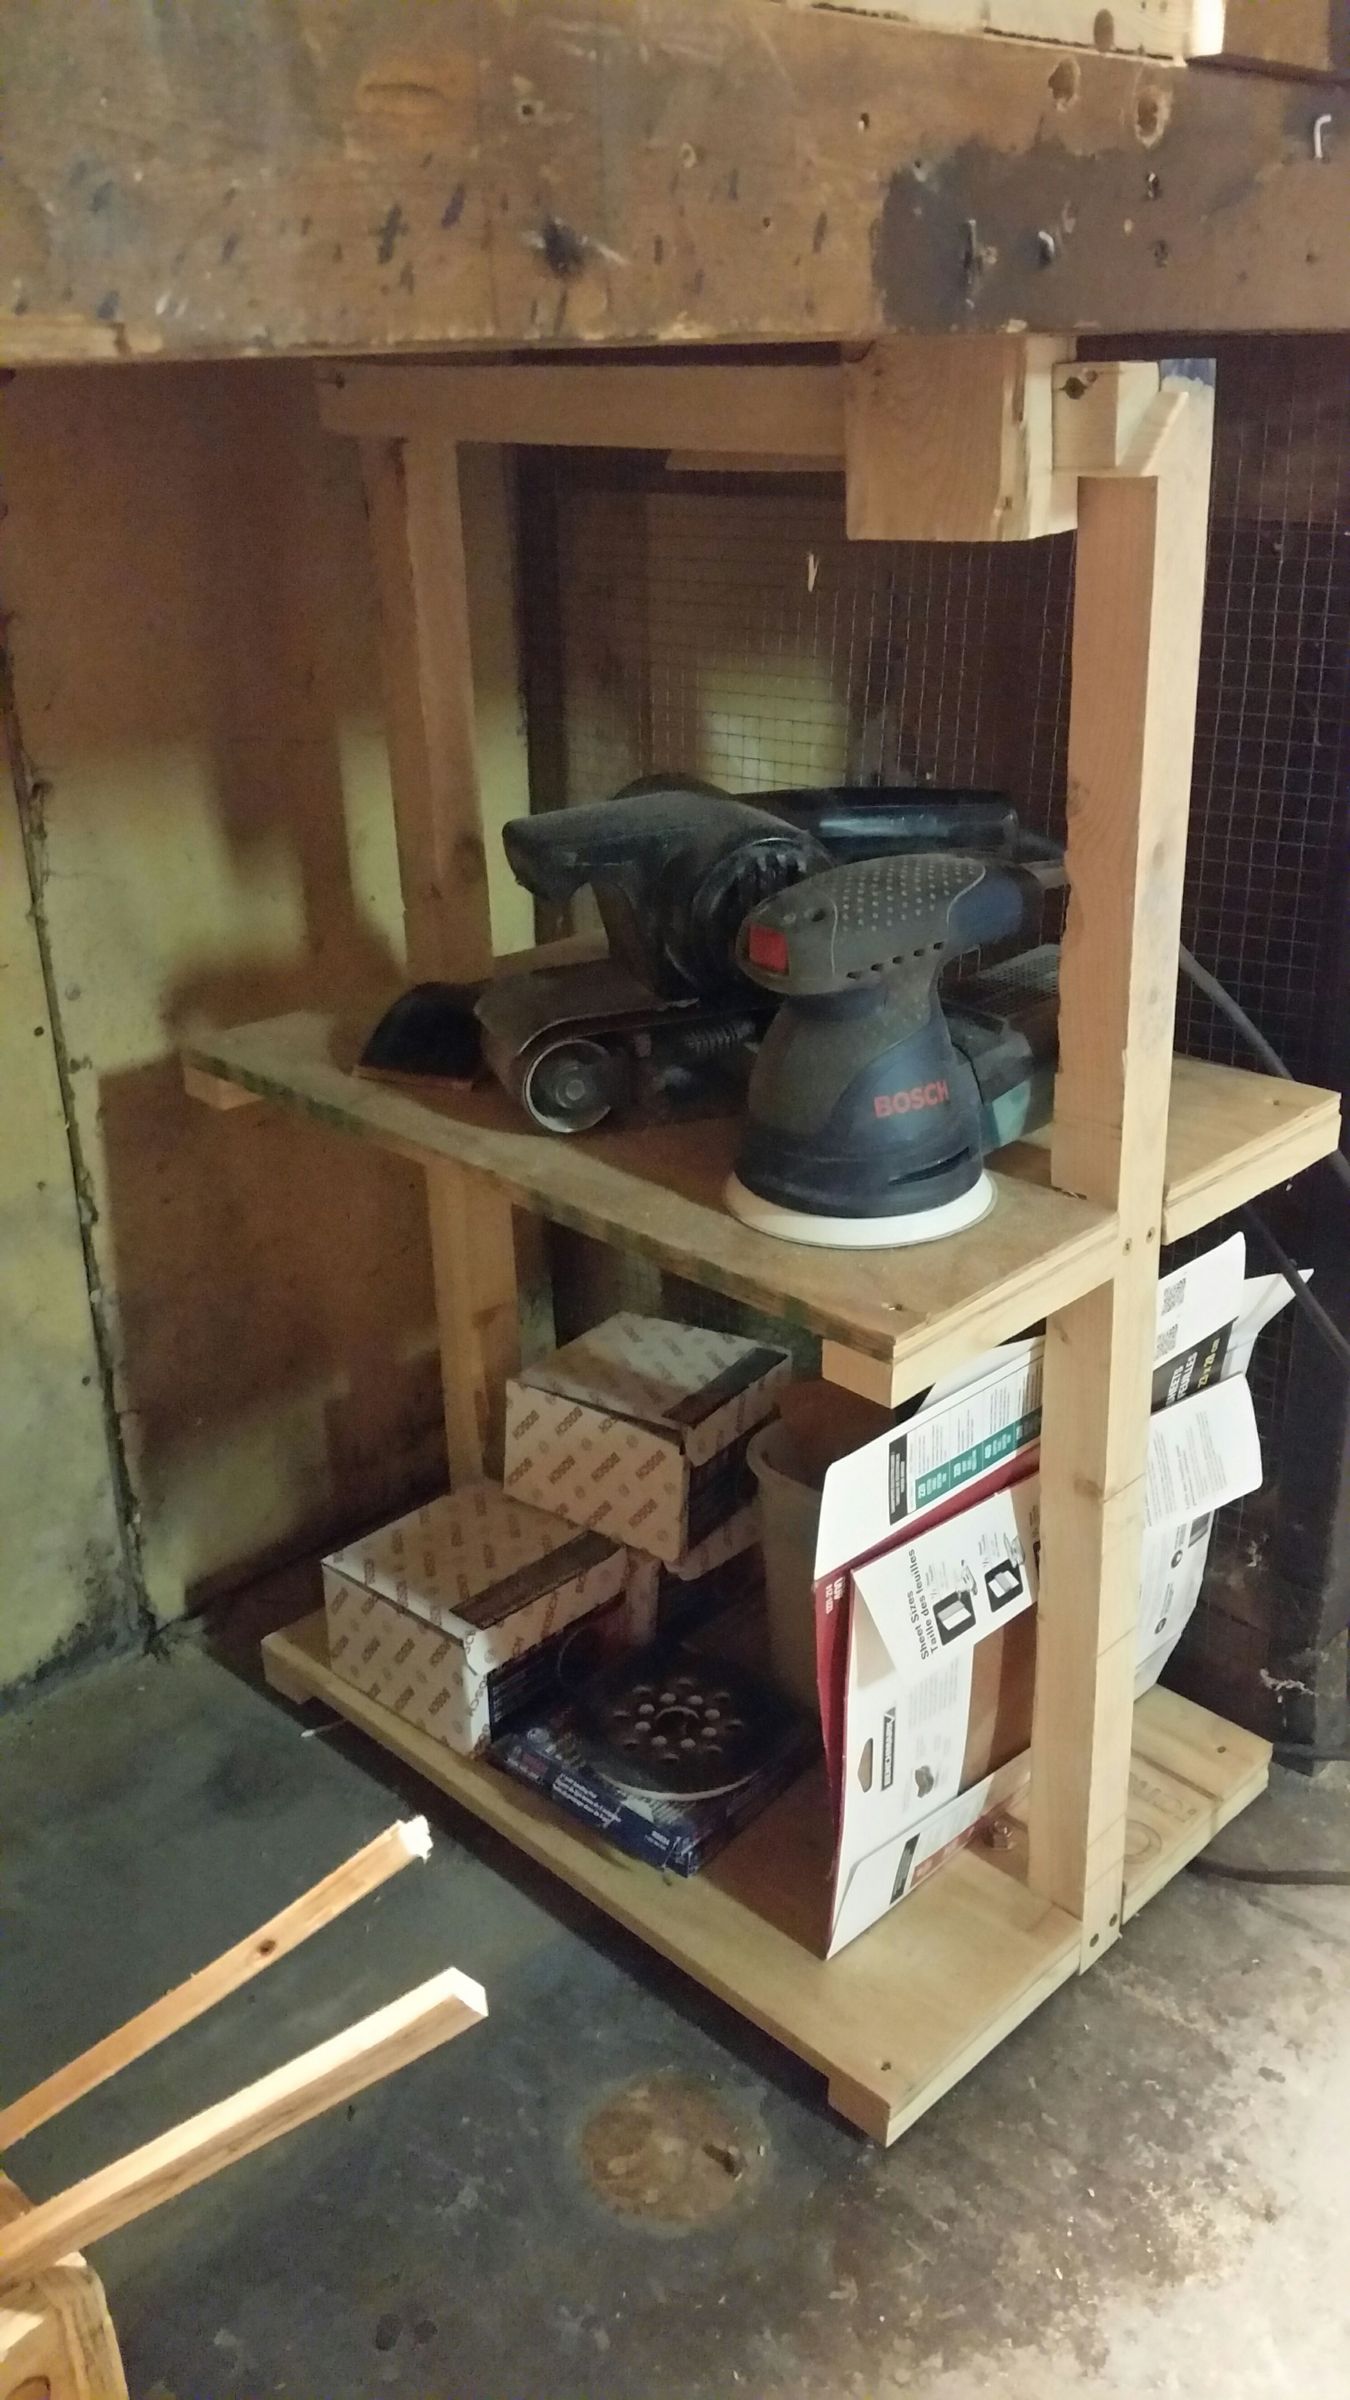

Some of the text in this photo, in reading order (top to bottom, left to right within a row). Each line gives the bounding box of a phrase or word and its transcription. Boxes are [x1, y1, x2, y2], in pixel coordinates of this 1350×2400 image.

[874, 1080, 949, 1118] BOSCH
[907, 1591, 930, 1660] Sheet Sizes
[908, 1549, 939, 1654] Taille des feuilles
